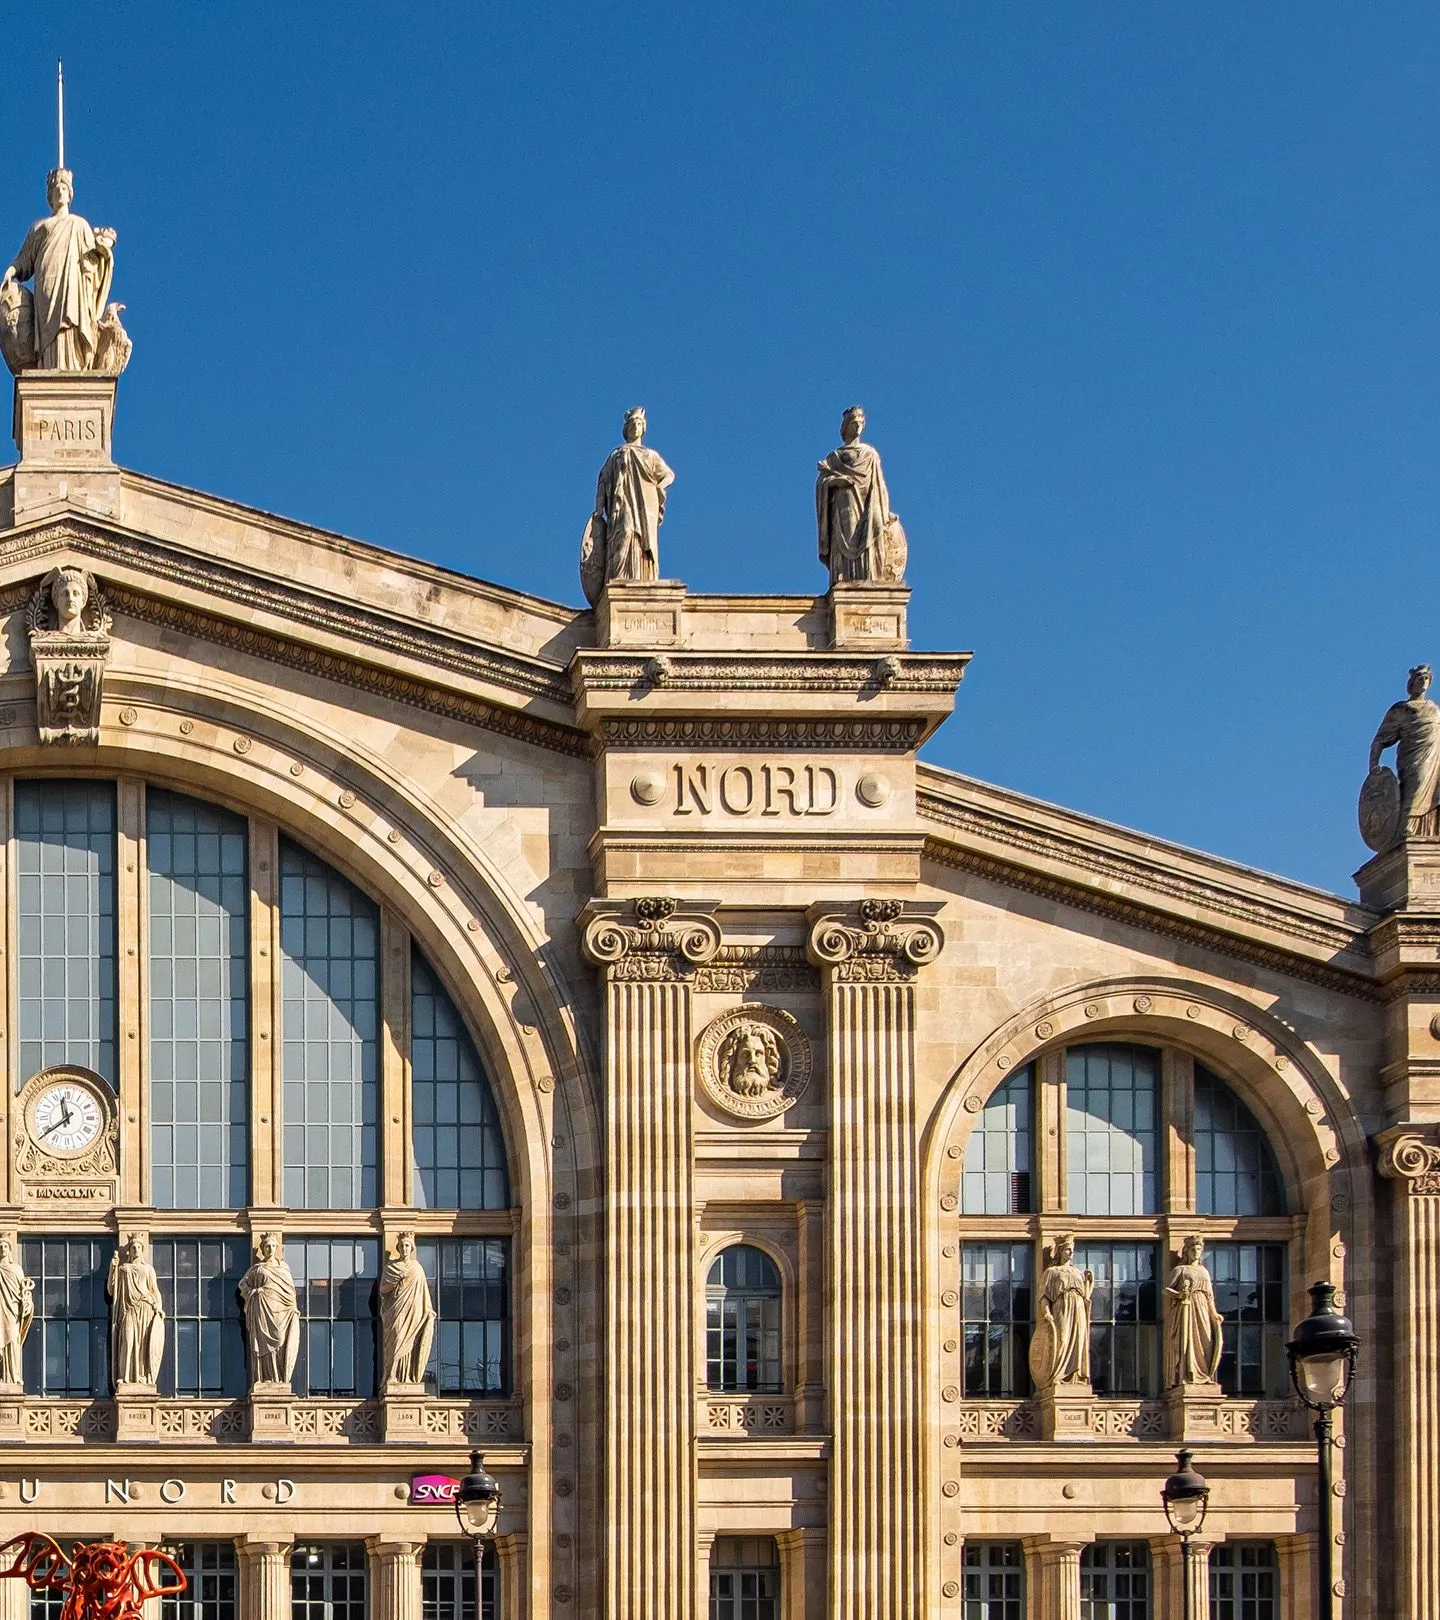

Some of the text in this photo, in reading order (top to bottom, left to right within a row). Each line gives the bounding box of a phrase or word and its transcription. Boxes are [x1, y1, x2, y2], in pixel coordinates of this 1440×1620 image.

[38, 419, 96, 441] PARIS
[671, 762, 844, 816] NORD
[105, 1478, 296, 1504] NORD
[415, 1484, 461, 1499] SNCF
